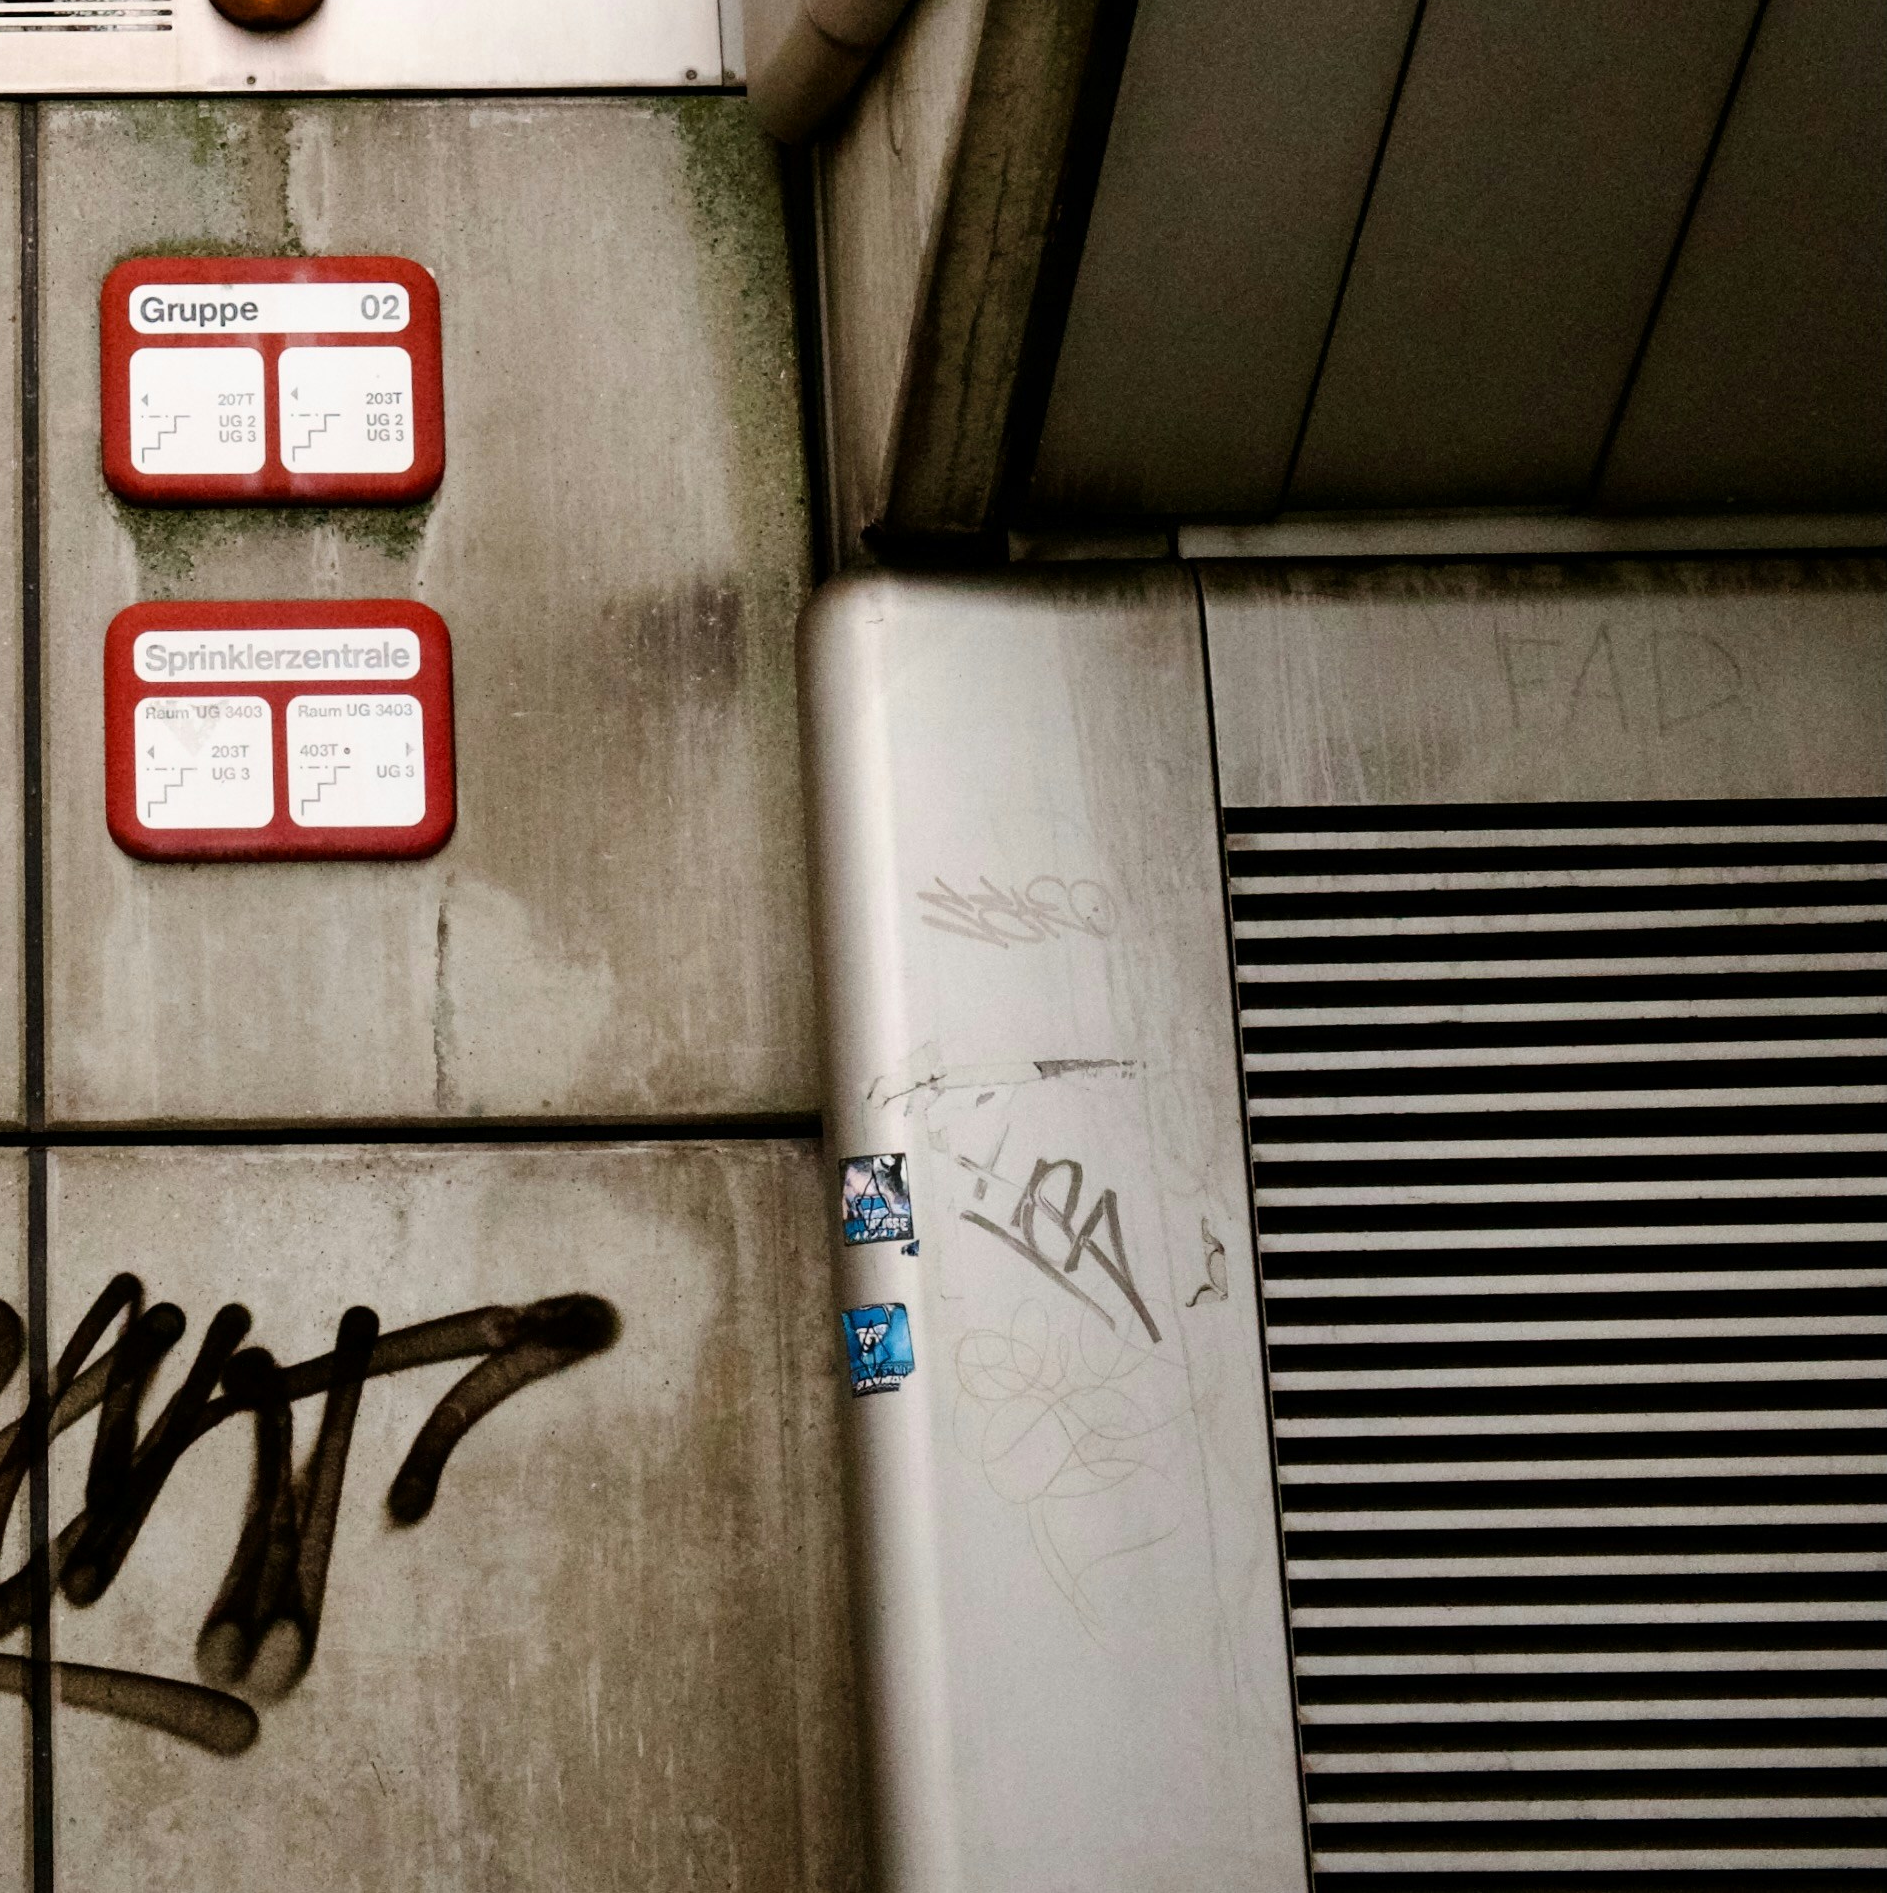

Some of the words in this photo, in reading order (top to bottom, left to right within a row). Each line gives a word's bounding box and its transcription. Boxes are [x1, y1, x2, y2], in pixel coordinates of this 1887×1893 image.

[141, 297, 258, 327] Gruppe
[361, 295, 400, 320] 02
[218, 393, 255, 406] 207T
[366, 392, 402, 404] 203T
[219, 415, 242, 427] UG
[248, 415, 256, 427] 2
[367, 413, 389, 426] UG
[395, 414, 403, 425] 2
[219, 430, 242, 443] UG
[248, 430, 256, 442] 3
[367, 429, 390, 441] UG
[396, 430, 404, 441] 3
[144, 642, 411, 677] Sprinklerzentrale
[146, 706, 189, 719] Raum
[195, 704, 220, 719] UG
[226, 705, 262, 718] 3403
[298, 705, 342, 718] Raum
[347, 703, 370, 716] UG
[376, 703, 413, 716] 3403
[212, 745, 249, 758] 203T
[300, 744, 338, 757] 403T
[212, 767, 235, 780] UG
[242, 768, 250, 780] 3
[377, 765, 400, 778] UG
[406, 765, 414, 777] 3
